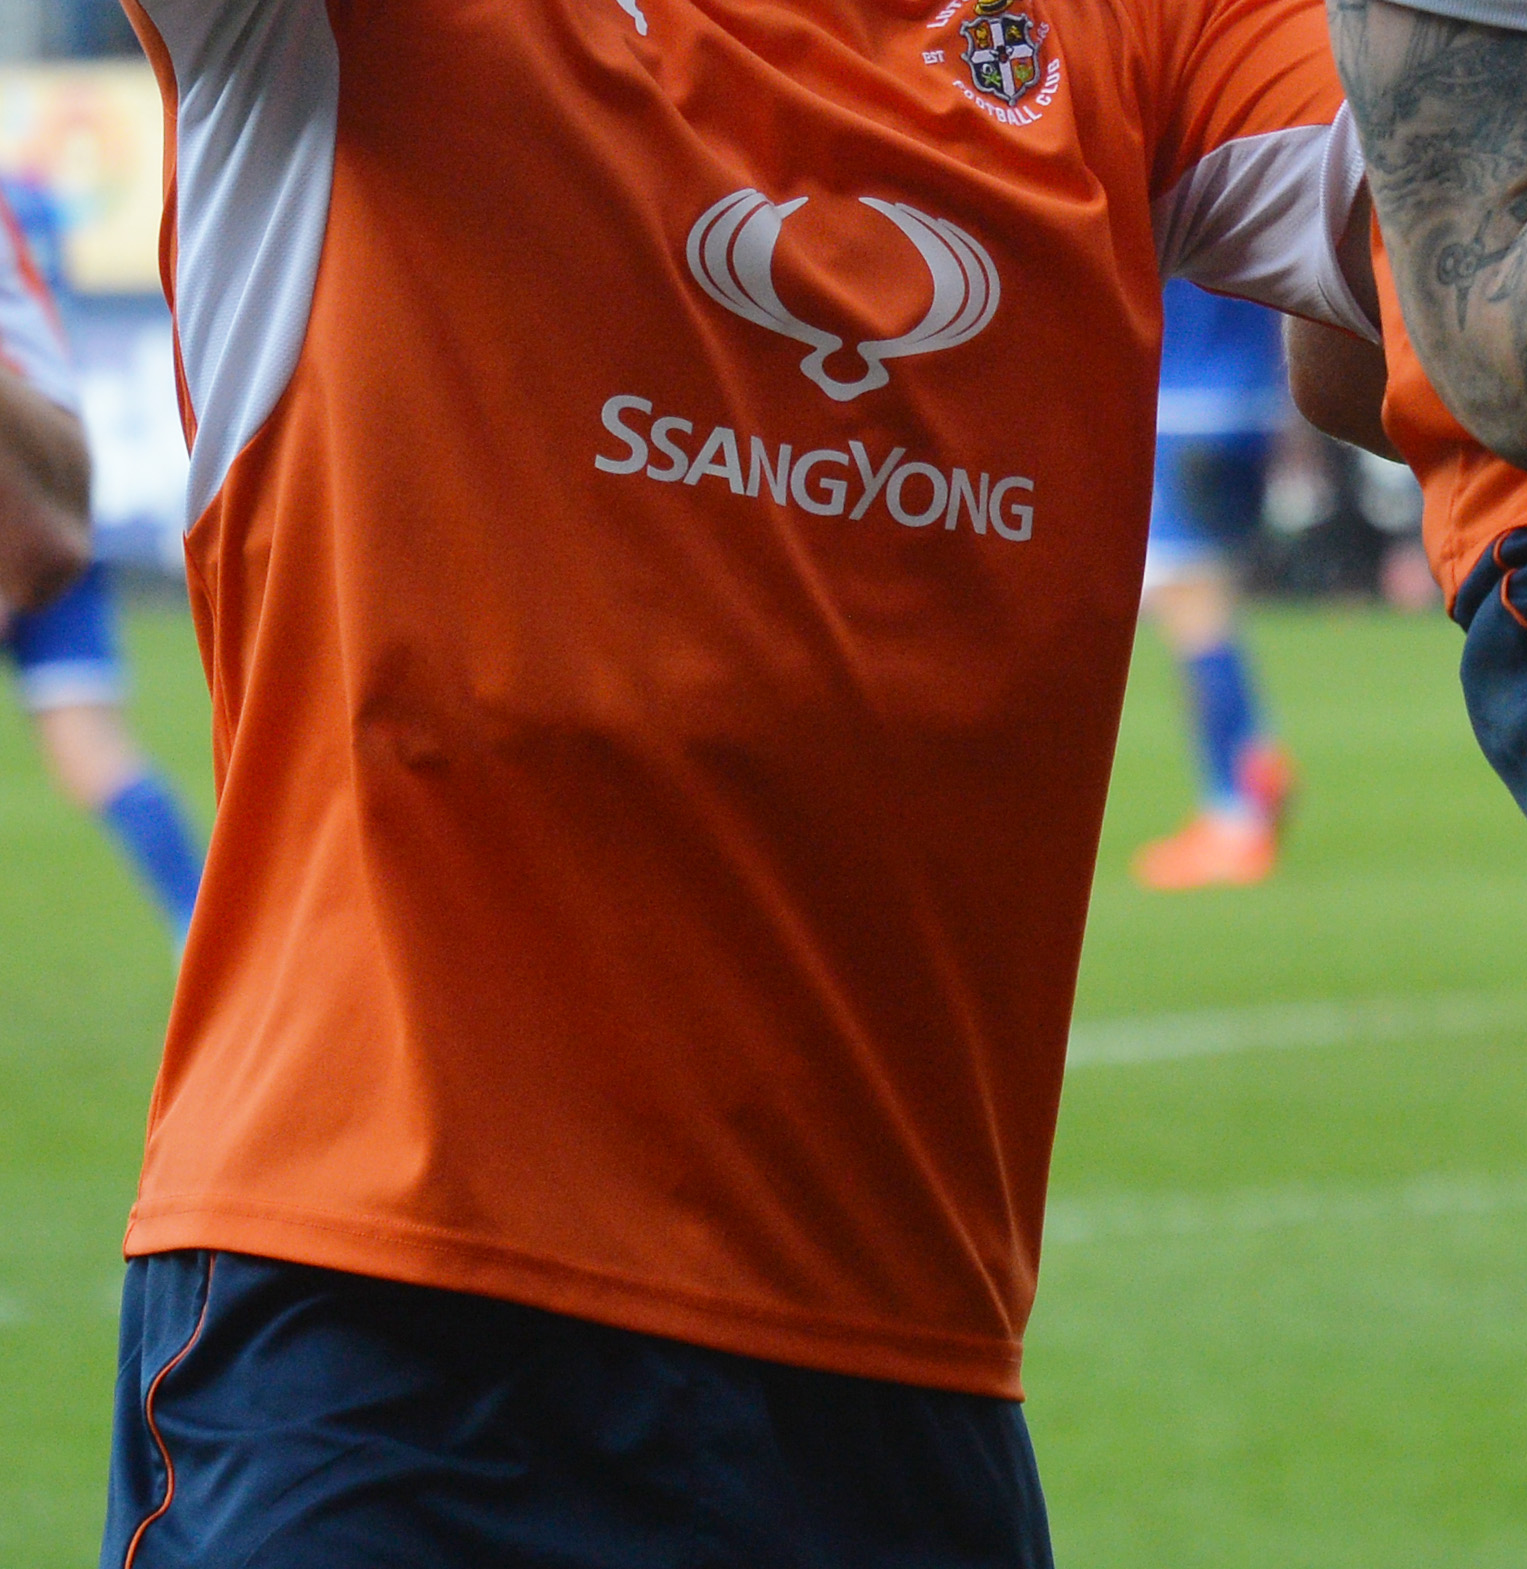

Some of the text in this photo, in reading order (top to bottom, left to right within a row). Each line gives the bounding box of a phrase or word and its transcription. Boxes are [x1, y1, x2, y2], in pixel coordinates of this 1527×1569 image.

[922, 50, 946, 64] EST
[953, 58, 1062, 127] FOOTBALL CLUB
[595, 394, 1035, 543] SSANGYONG
